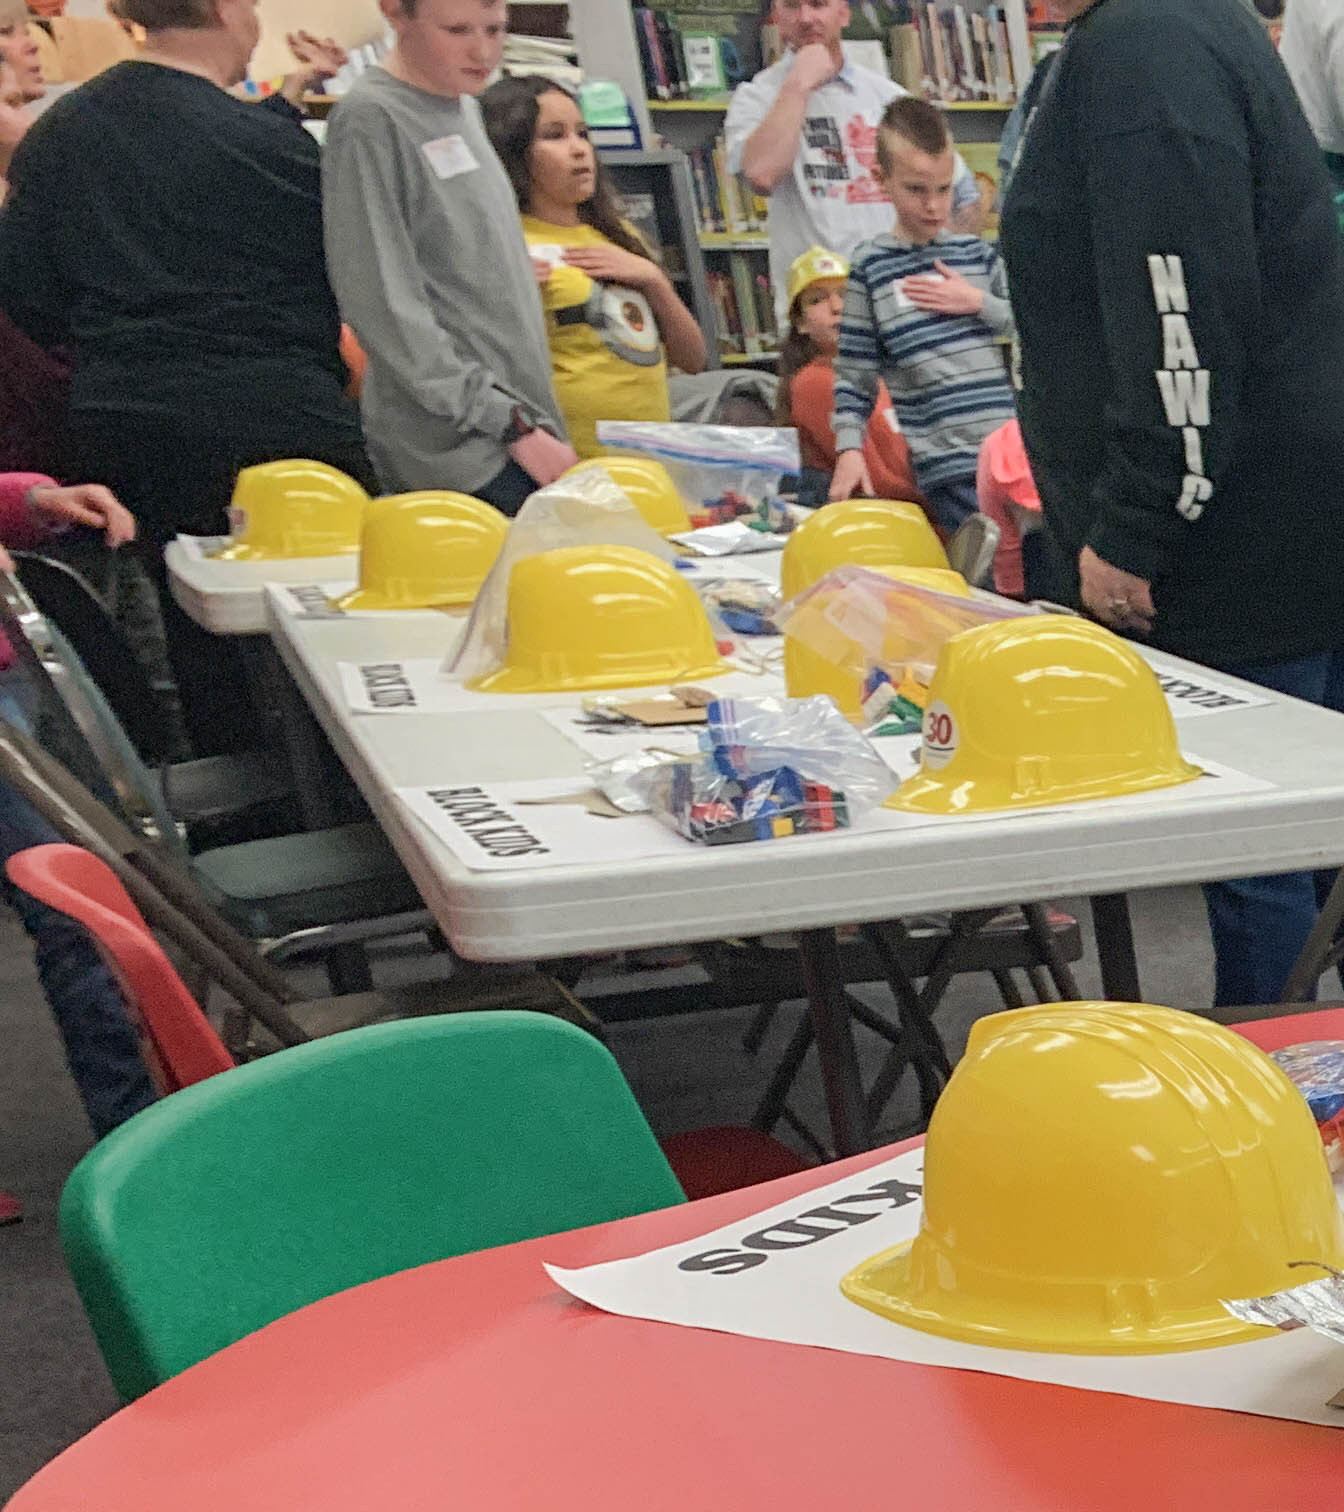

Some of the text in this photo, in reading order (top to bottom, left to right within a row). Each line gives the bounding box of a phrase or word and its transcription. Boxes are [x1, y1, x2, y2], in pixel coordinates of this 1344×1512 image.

[1147, 253, 1213, 520] NAWIC
[927, 712, 953, 745] 30
[426, 786, 550, 857] BLOCK KIDS
[678, 1179, 923, 1275] KIDS
